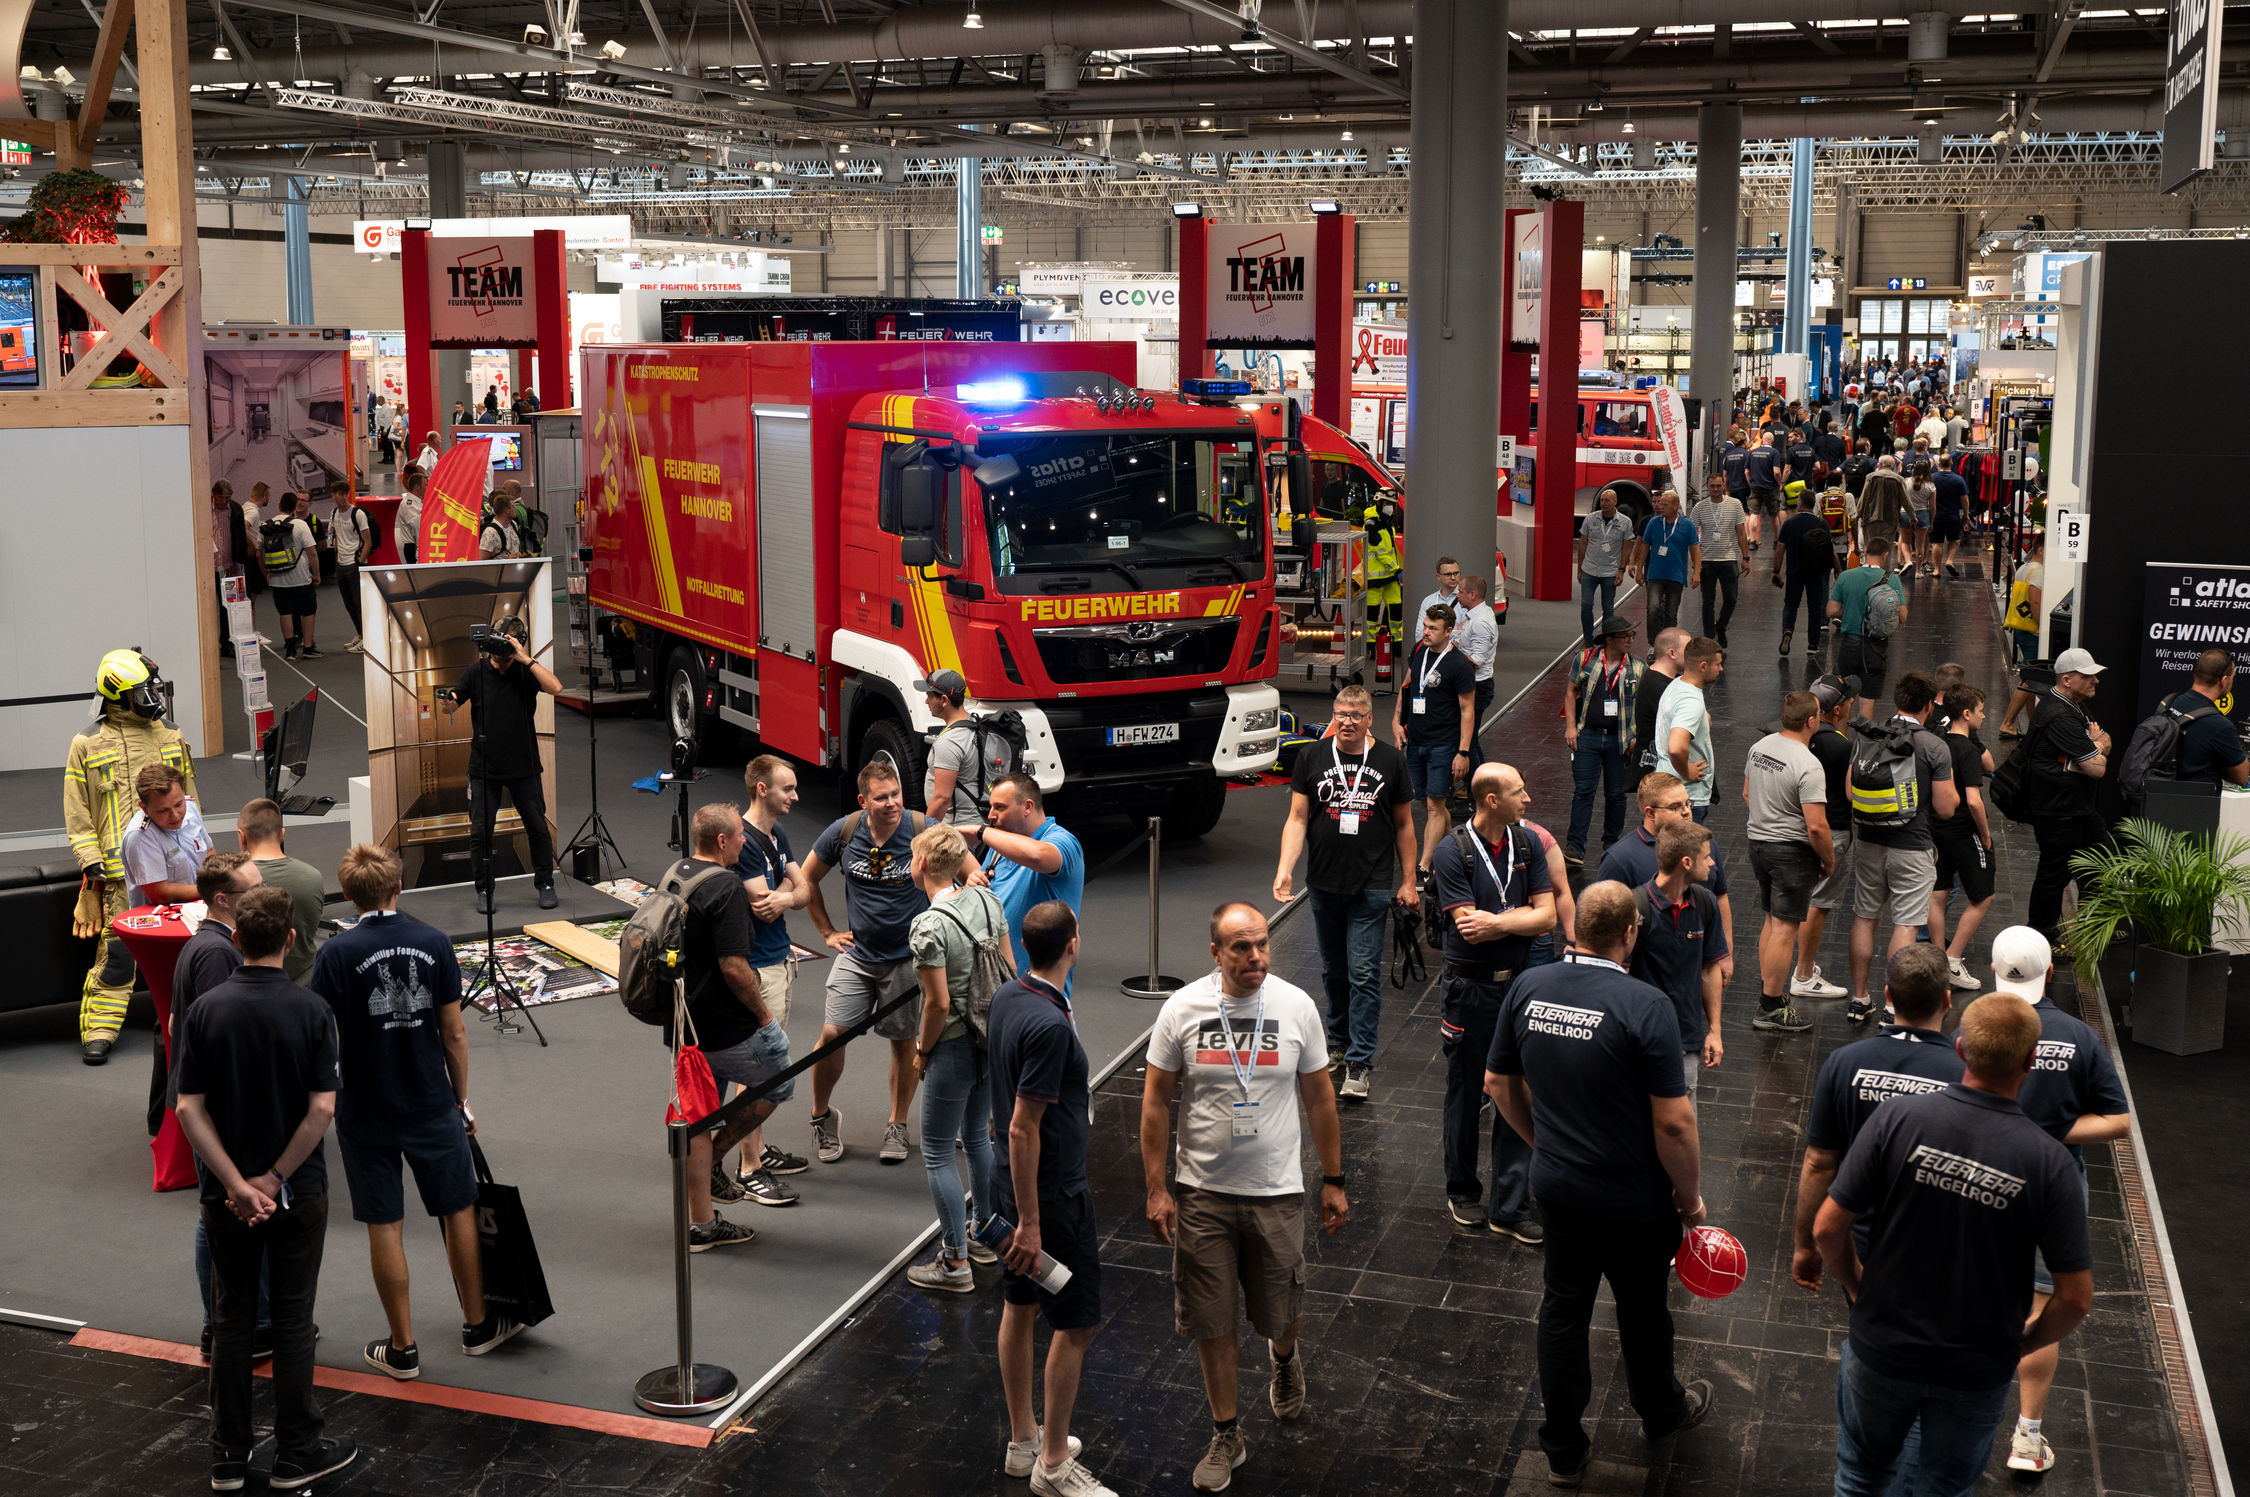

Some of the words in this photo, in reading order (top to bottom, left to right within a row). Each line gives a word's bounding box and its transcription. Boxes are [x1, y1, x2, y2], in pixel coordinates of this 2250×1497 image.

[447, 266, 523, 298] TEAM
[1226, 256, 1305, 292] TEAM
[660, 283, 700, 291] FIGHTING
[701, 283, 742, 291] SYSTEMS
[1390, 282, 1399, 292] 13
[1915, 279, 1925, 288] 13
[448, 299, 487, 307] FEUERWEHR
[1226, 293, 1266, 302] FEUERWEHR
[899, 330, 943, 341] FEUER
[954, 330, 993, 341] WEHR
[629, 364, 700, 383] KATASTROPHENSCHUTZ
[1502, 440, 1510, 452] B
[2008, 454, 2017, 466] B
[664, 458, 721, 486] FEUERWEHR
[680, 494, 733, 523] HANNOVER
[2068, 521, 2081, 538] B
[2067, 540, 2079, 549] 59
[686, 575, 745, 606] NOTFALLRETTUNG
[1021, 593, 1180, 622] FEUERWEHR
[2194, 598, 2231, 609] SAFETY
[1108, 649, 1174, 669] MAN
[2155, 648, 2172, 659] Wir
[2173, 649, 2202, 660] verlos
[2161, 660, 2194, 672] Reisen
[1116, 728, 1127, 742] H
[1132, 727, 1150, 741] FW
[1151, 725, 1174, 740] 274
[1323, 763, 1358, 779] PREIUM
[355, 947, 396, 975] Freiwillige
[396, 946, 436, 967] Feuerwehr
[1524, 1000, 1605, 1029] FEUERWEHR
[1528, 1018, 1594, 1041] ENGELROD
[1907, 1145, 2027, 1198] FEUERWEHR
[1914, 1167, 2009, 1211] ENGELROD
